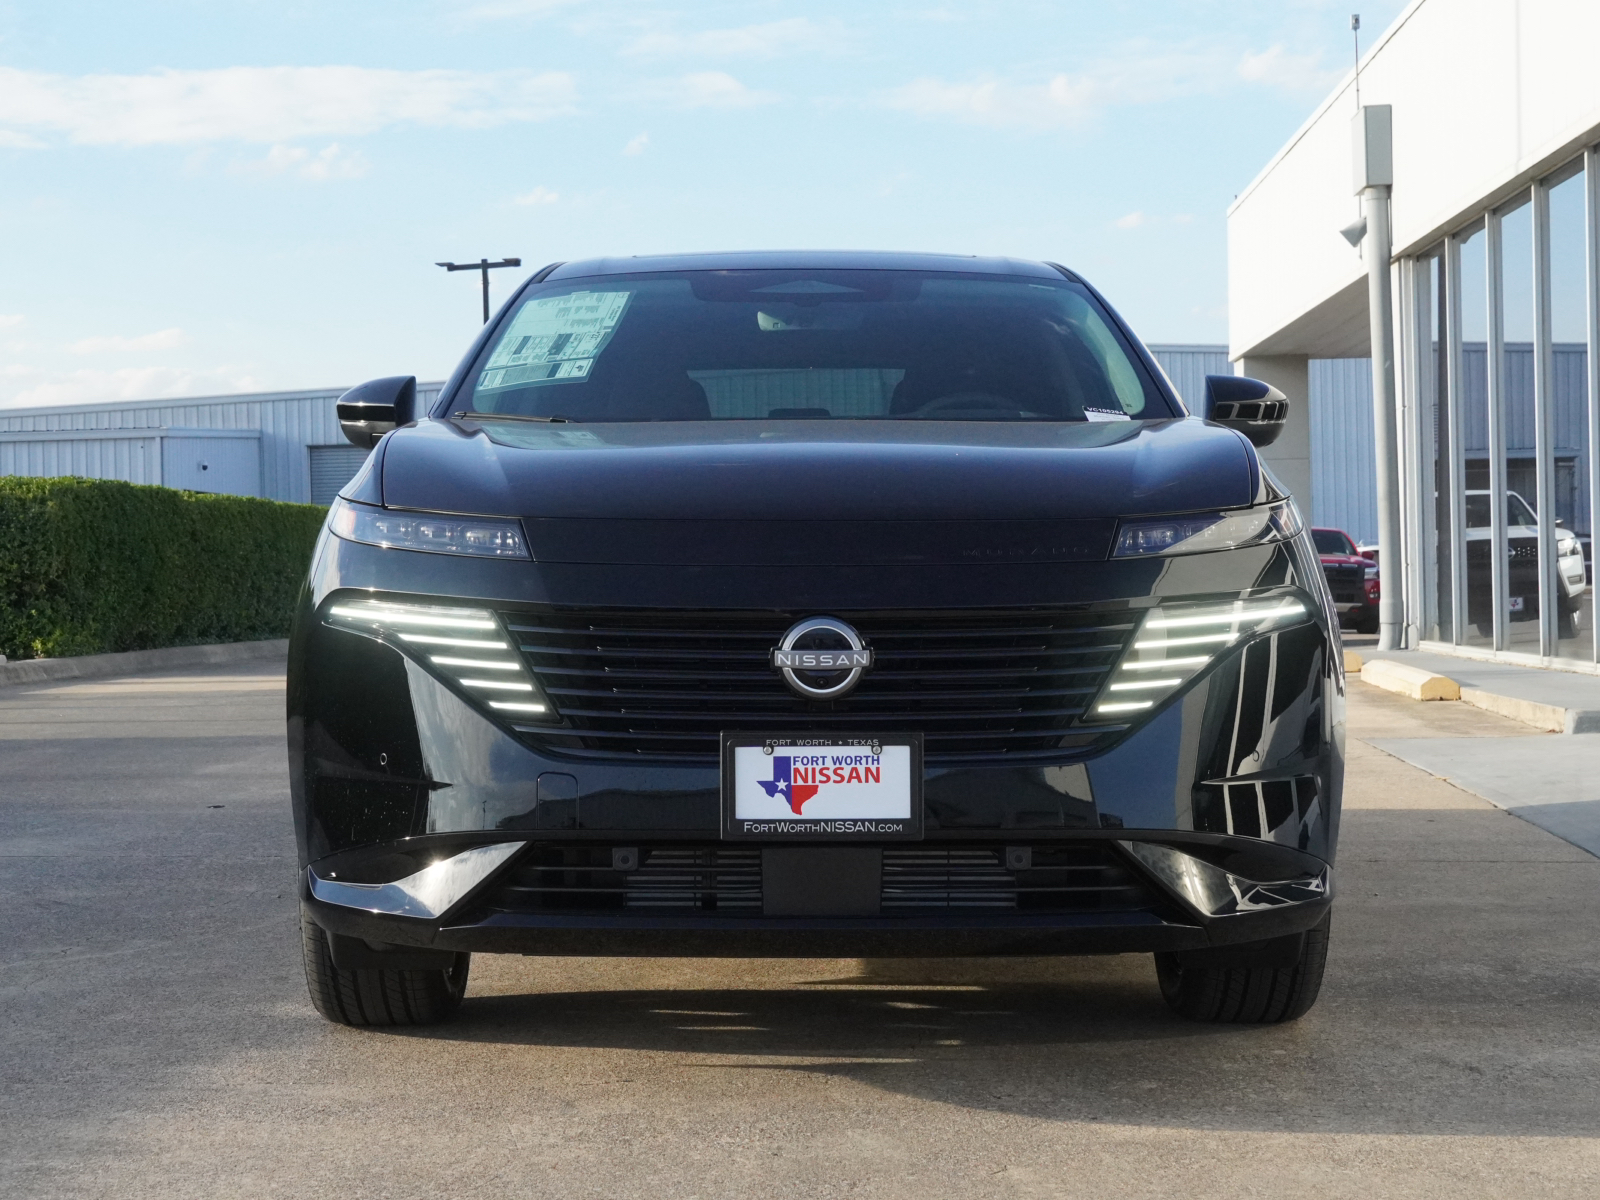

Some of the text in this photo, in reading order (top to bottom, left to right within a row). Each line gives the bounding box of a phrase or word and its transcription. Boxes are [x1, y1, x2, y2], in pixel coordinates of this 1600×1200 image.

[777, 653, 867, 666] NISSAN
[793, 755, 880, 766] FORT WORTH
[793, 766, 880, 784] NISSAN
